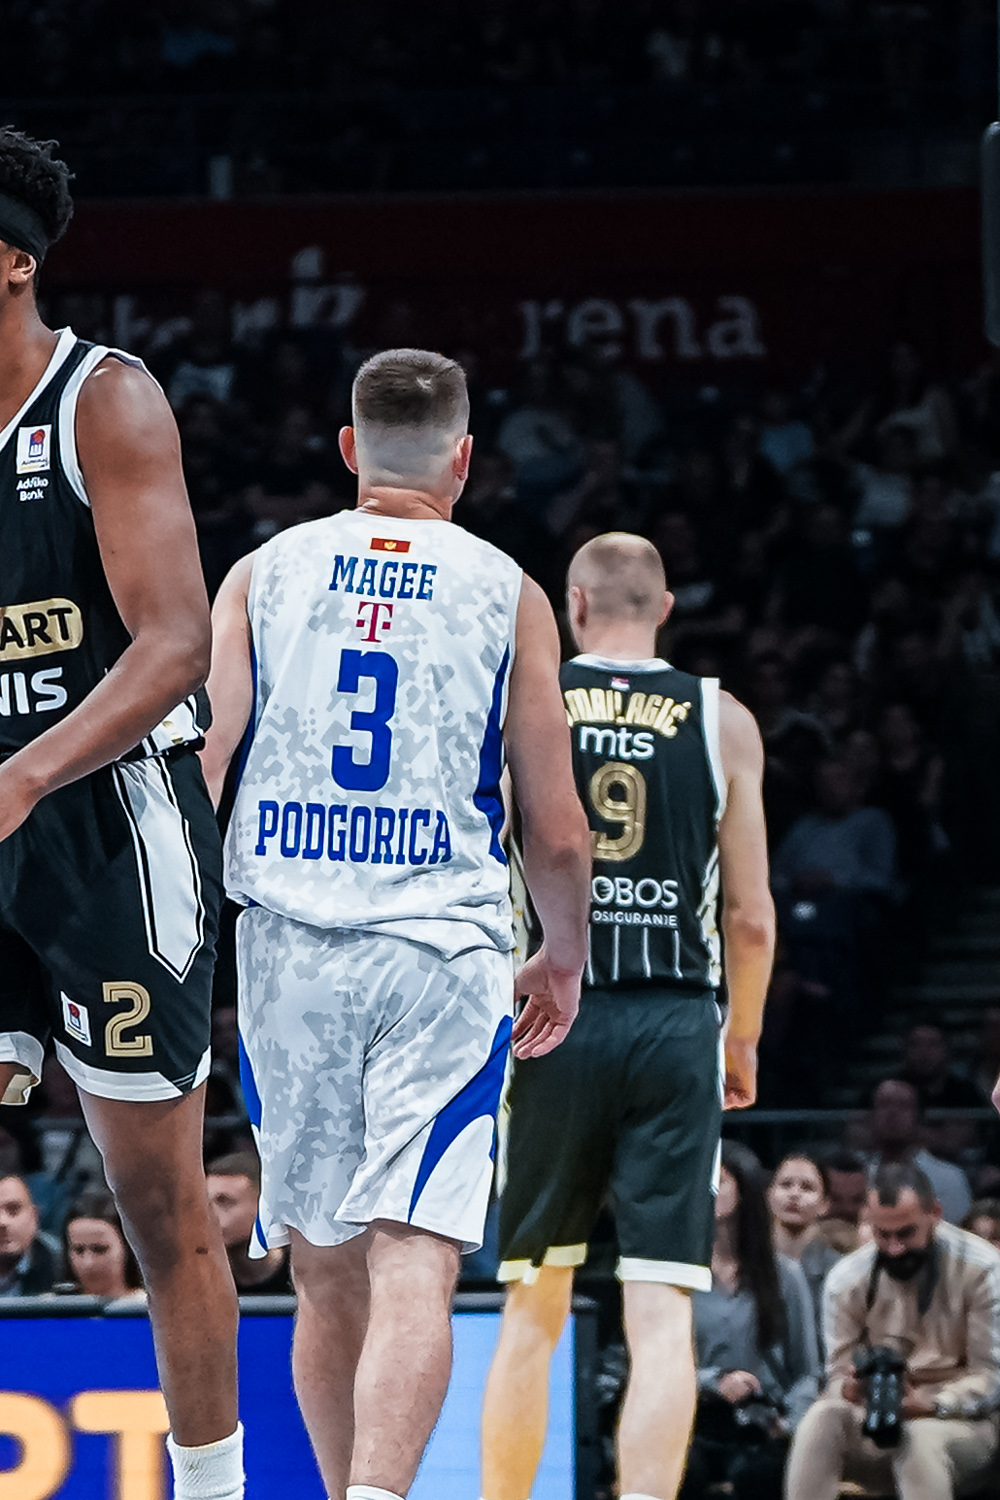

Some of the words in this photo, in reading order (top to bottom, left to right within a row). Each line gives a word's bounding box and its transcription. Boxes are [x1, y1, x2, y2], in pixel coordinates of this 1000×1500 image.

[19, 488, 45, 502] Bank
[328, 555, 437, 601] MAGEE
[331, 648, 399, 792] 3
[564, 687, 692, 739] MAILAGIĆ
[579, 725, 655, 760] mts
[254, 800, 453, 866] PODGORICA
[589, 761, 648, 862] 9
[590, 876, 679, 909] OBOS
[102, 981, 153, 1057] 2
